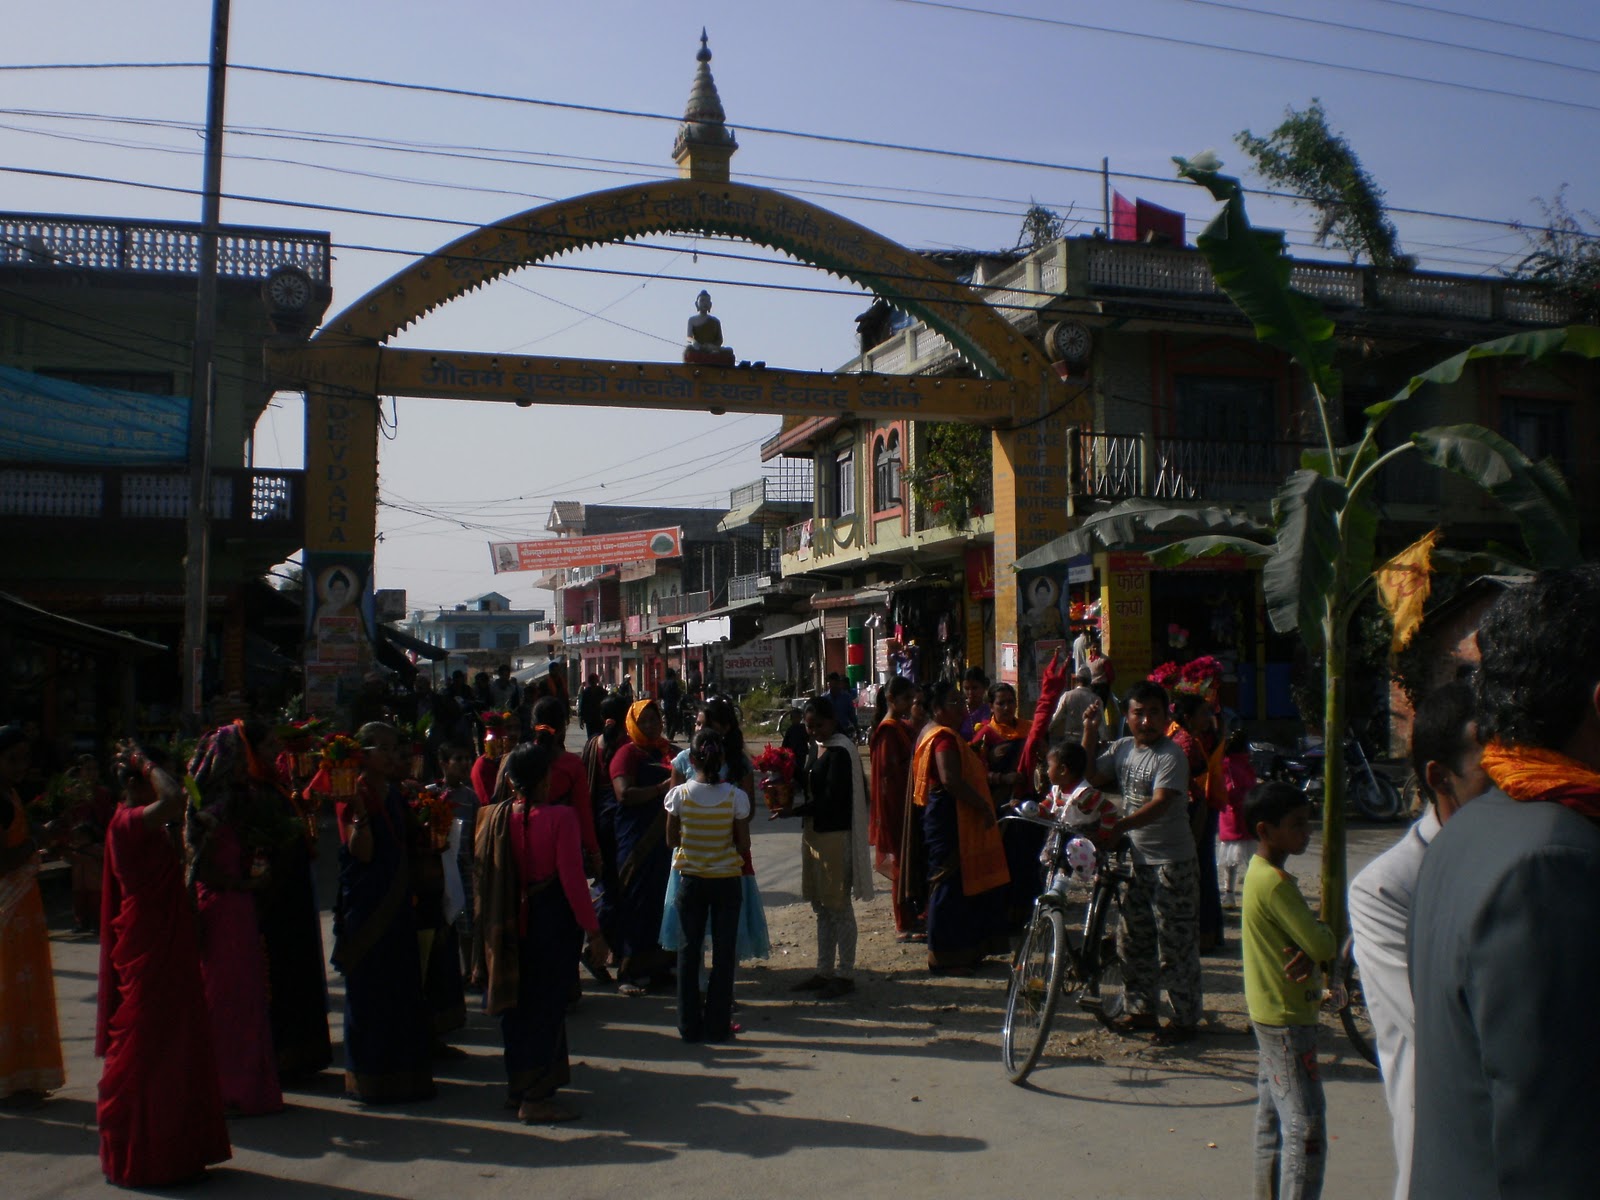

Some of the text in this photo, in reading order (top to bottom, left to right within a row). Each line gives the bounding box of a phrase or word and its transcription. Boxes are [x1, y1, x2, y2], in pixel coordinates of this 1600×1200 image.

[1016, 431, 1058, 446] PLACE
[326, 403, 351, 543] DEVDAHA
[1023, 479, 1057, 493] THE
